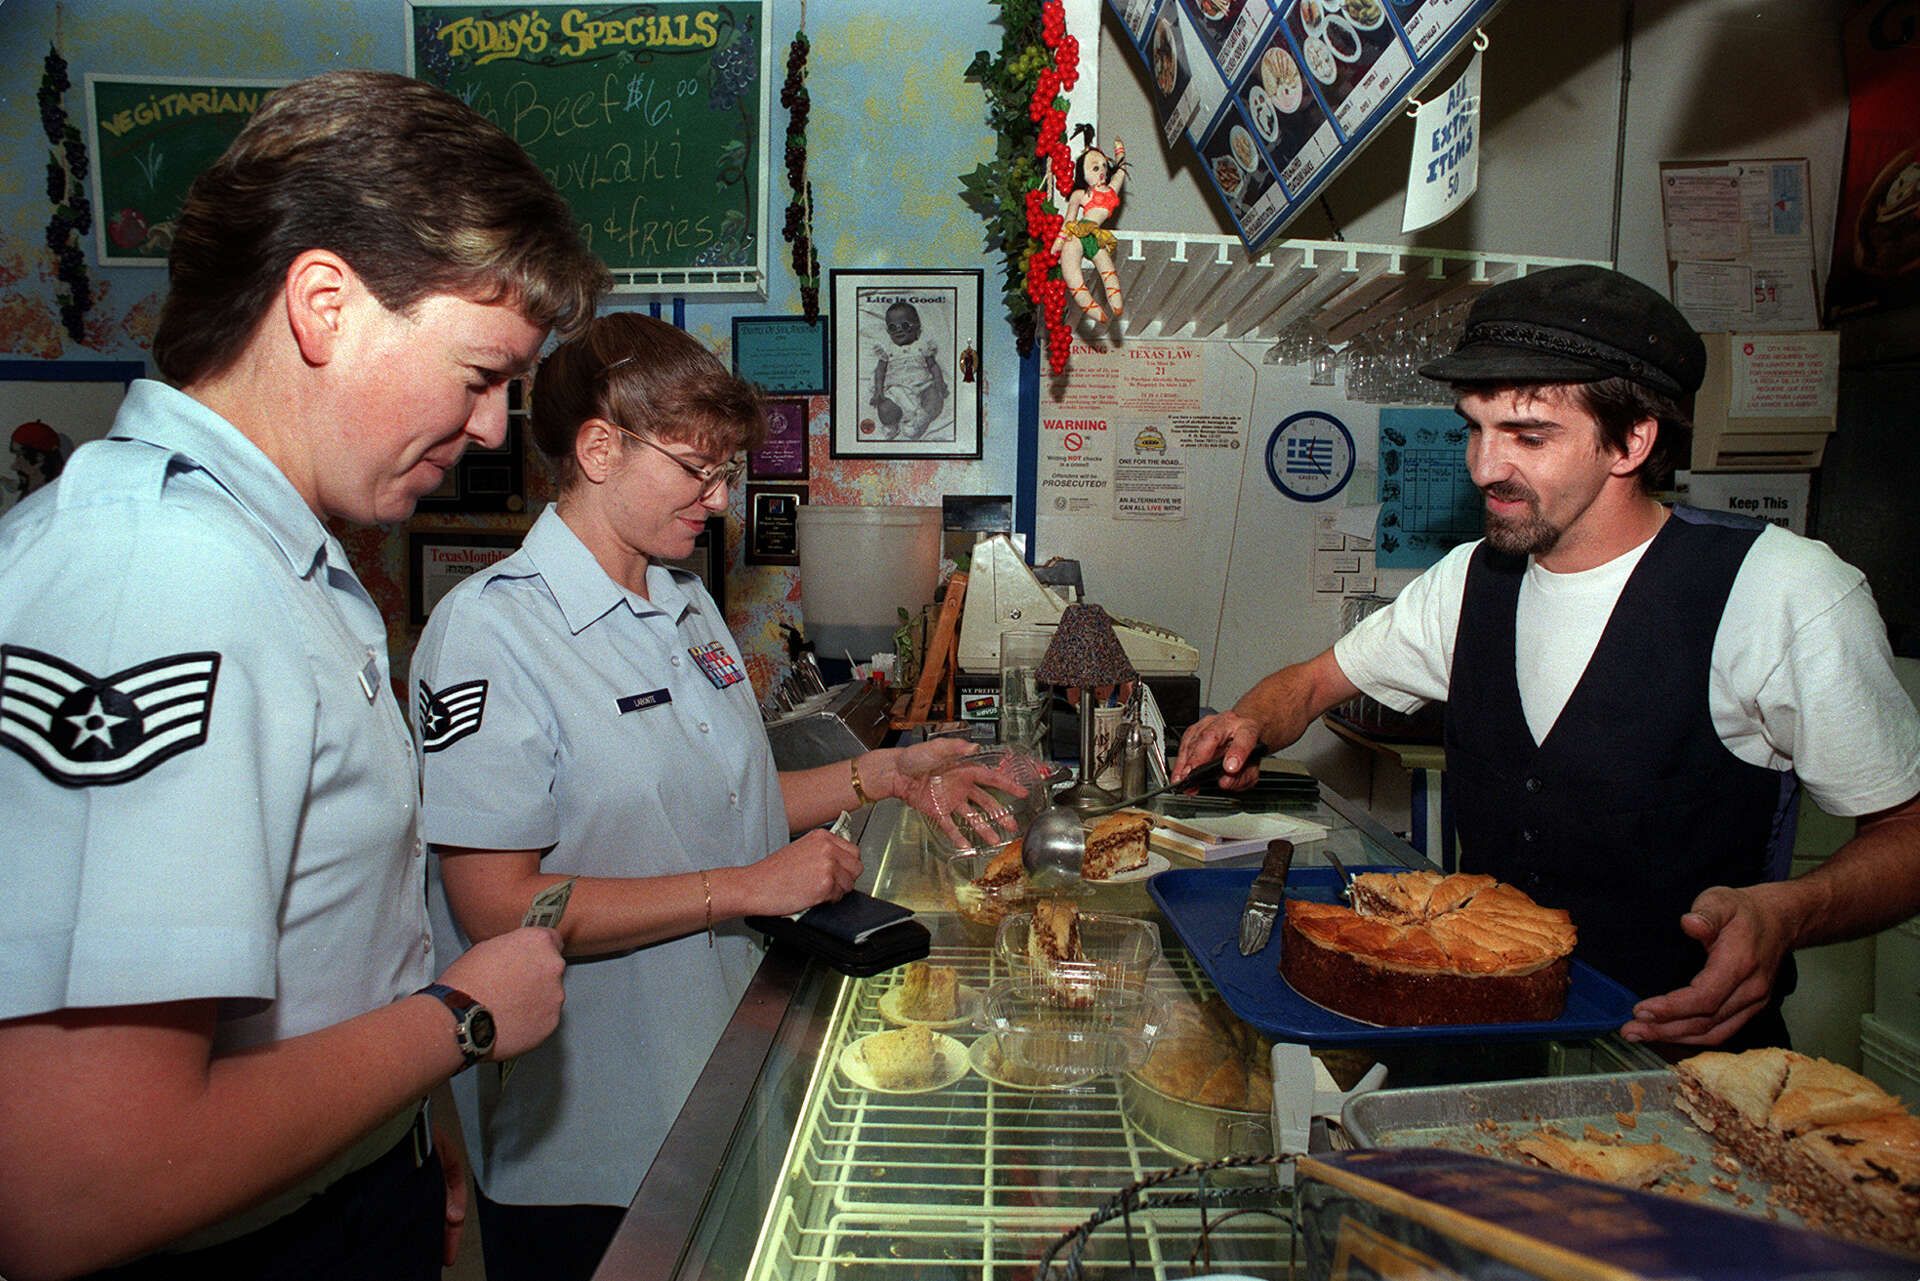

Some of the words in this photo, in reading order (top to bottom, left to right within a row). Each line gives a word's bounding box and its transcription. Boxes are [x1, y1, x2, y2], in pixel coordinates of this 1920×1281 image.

[1426, 126, 1473, 184] ITEMS
[866, 296, 892, 304] Life
[895, 296, 907, 304] is
[908, 296, 946, 304] Good!
[1071, 345, 1108, 356] RNING
[1129, 350, 1165, 360] TEXAS
[1167, 350, 1192, 360] LAW
[1155, 367, 1166, 375] 21
[1043, 420, 1107, 431] WARNING
[1729, 497, 1759, 512] Keep
[1763, 496, 1789, 510] This
